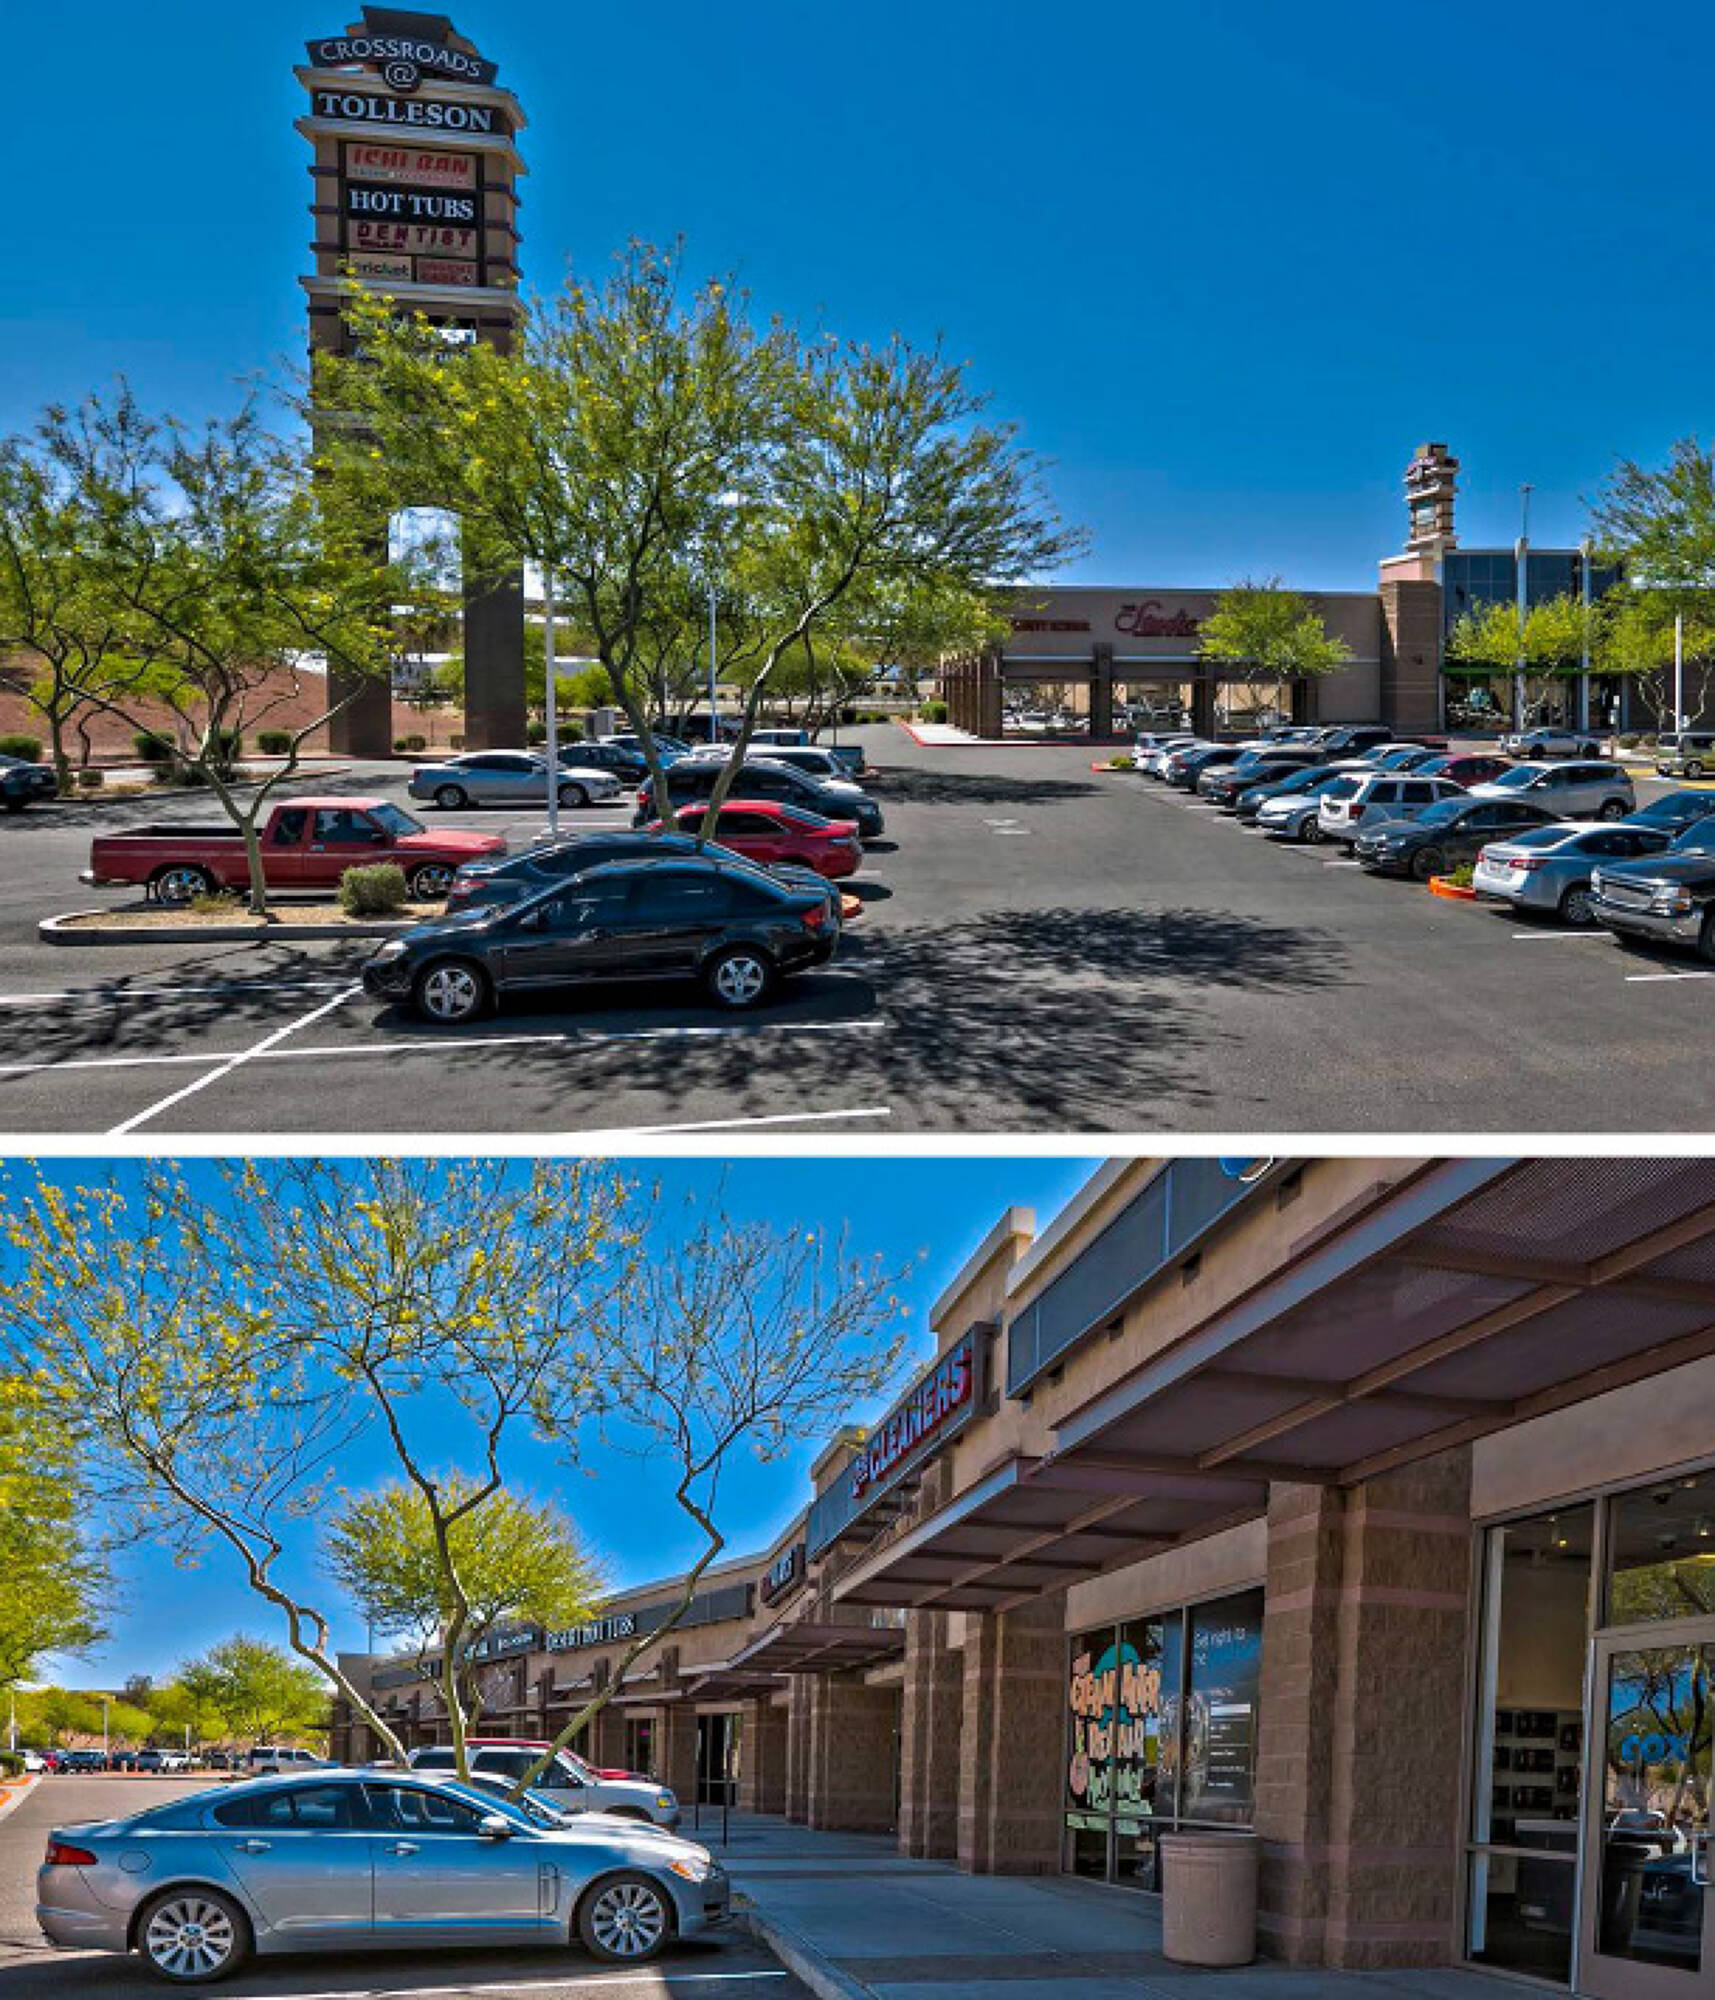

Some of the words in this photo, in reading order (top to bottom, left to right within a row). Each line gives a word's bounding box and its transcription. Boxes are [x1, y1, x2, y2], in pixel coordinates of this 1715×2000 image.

[320, 38, 481, 78] CROSSROADS
[384, 61, 418, 89] @
[317, 92, 494, 132] TOLLESON
[349, 189, 403, 213] HOT
[408, 194, 475, 220] TUBS
[356, 222, 472, 247] DENTIST
[868, 1345, 974, 1482] CLEANERS
